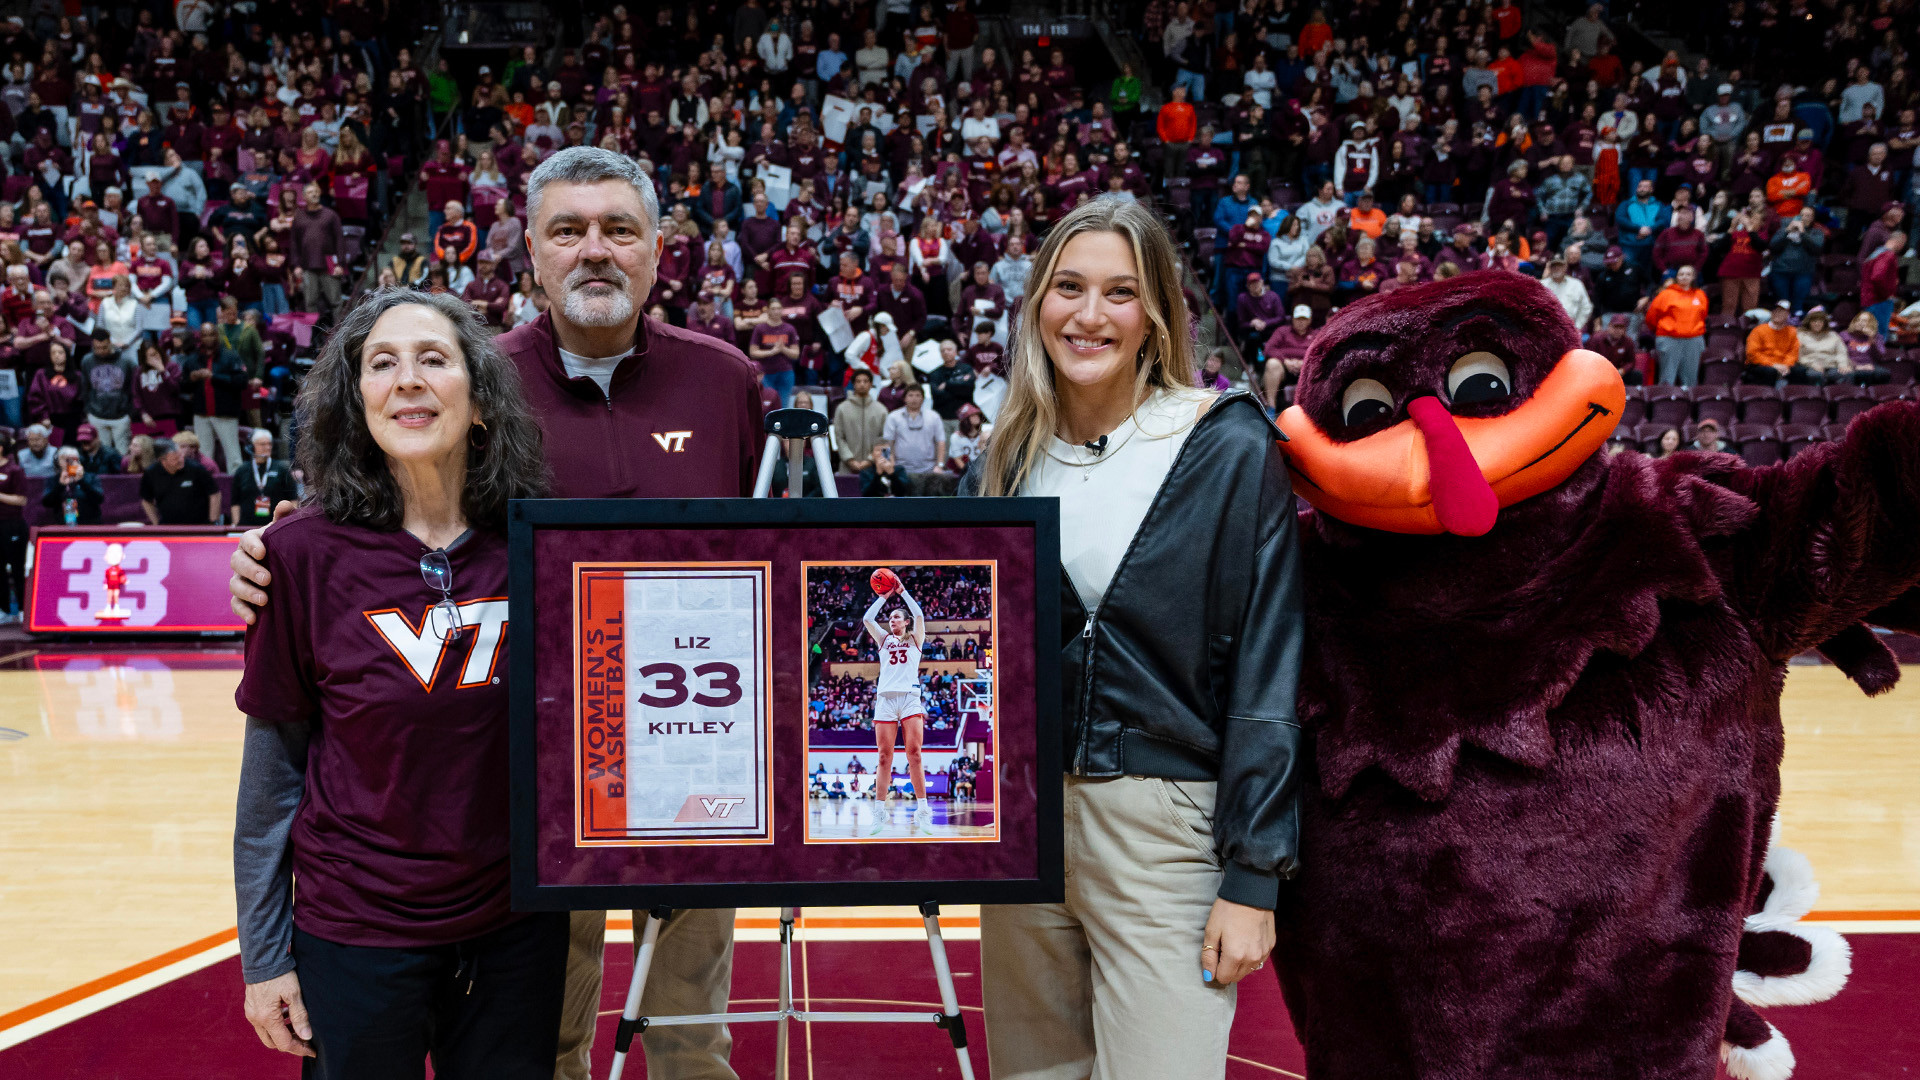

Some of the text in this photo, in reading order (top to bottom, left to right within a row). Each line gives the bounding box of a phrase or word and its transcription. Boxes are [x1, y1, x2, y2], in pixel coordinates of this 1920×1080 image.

[1022, 24, 1069, 36] 114 115
[650, 430, 694, 453] VT
[57, 540, 171, 627] 33
[362, 596, 509, 694] VT
[674, 636, 711, 650] LIZ
[888, 649, 908, 665] 33
[637, 661, 743, 709] 33
[586, 628, 606, 781] WOMEN'S
[605, 610, 625, 798] BASKETBALL
[648, 721, 736, 735] KITLEY
[699, 797, 746, 819] VT
